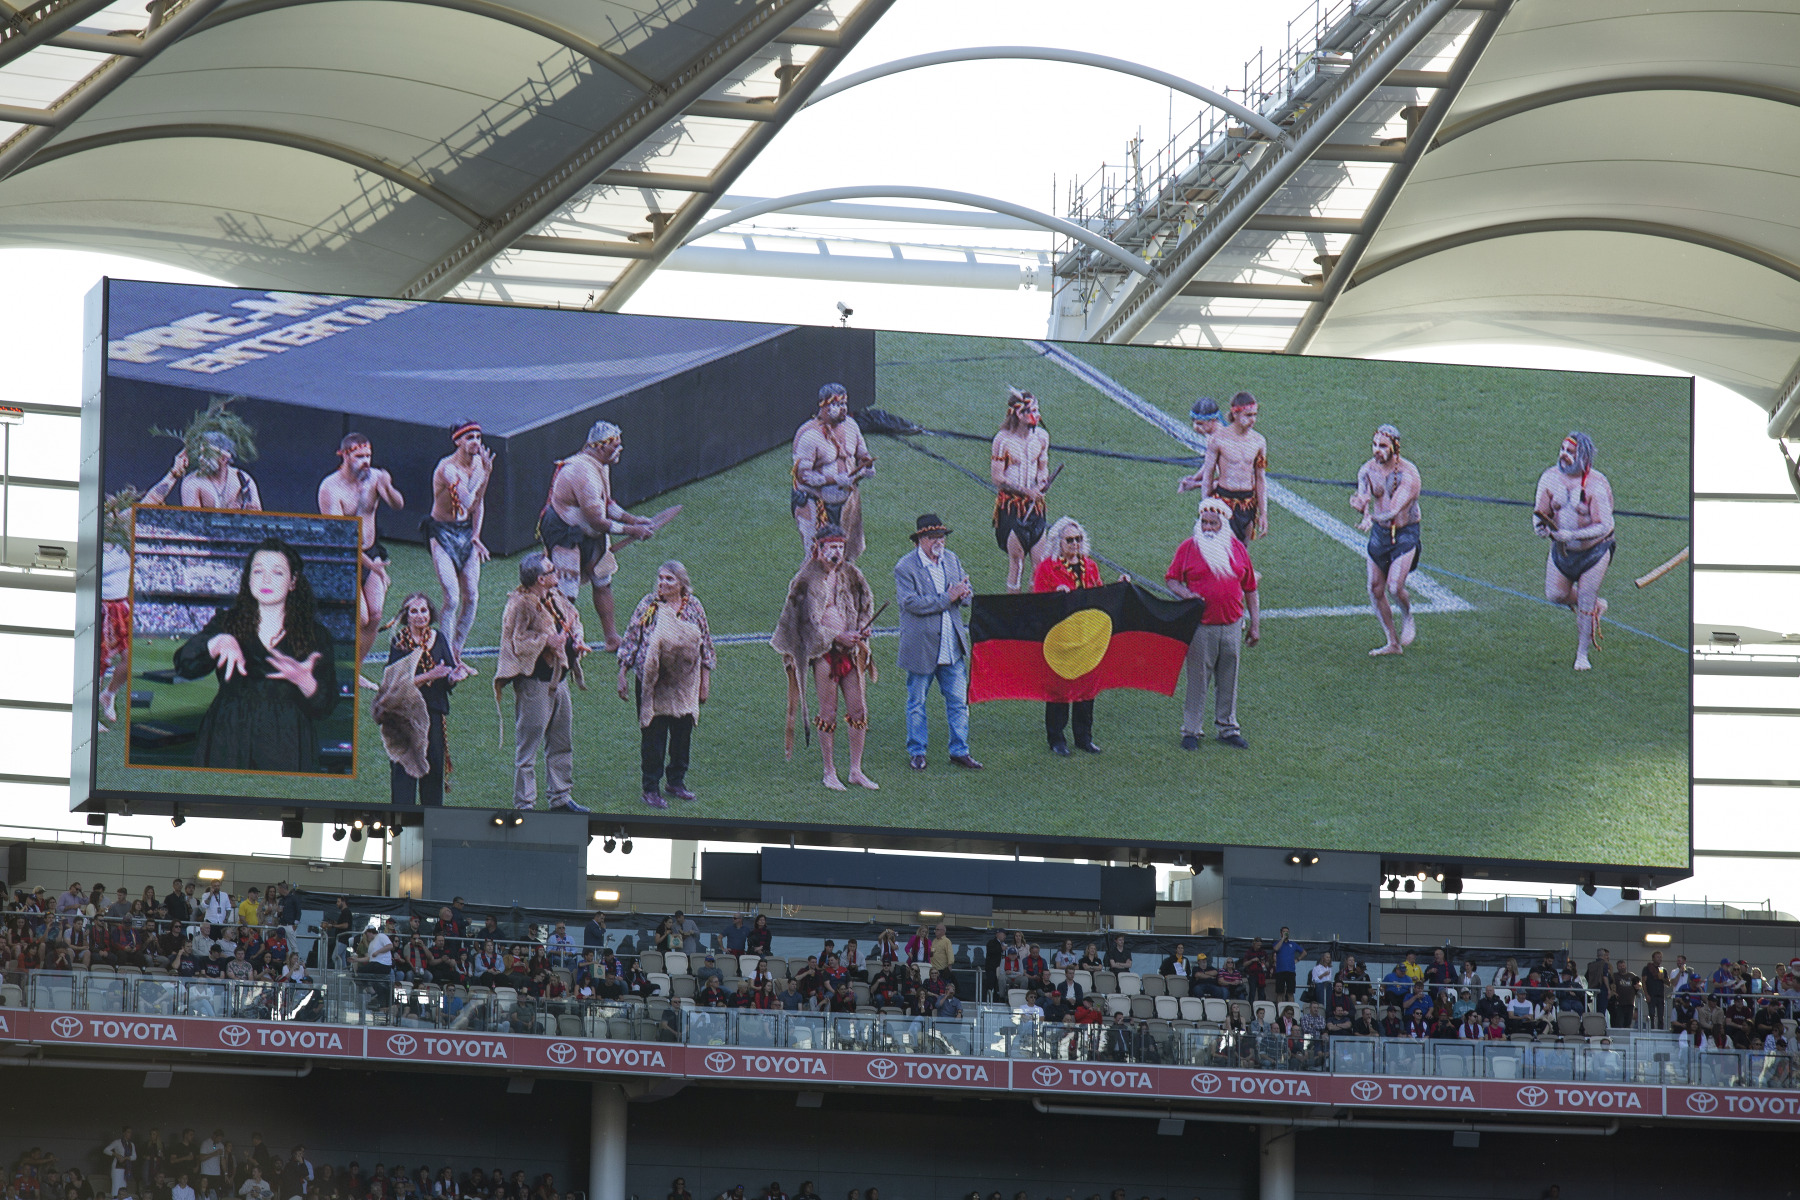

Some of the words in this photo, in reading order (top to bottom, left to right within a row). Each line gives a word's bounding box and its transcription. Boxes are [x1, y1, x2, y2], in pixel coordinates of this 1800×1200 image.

[90, 1021, 177, 1040] TOYOTA
[257, 1029, 342, 1049] TOYOTA
[424, 1038, 507, 1058] TOYOTA
[583, 1047, 665, 1067] TOYOTA
[742, 1056, 827, 1074] TOYOTA
[904, 1062, 988, 1082] TOYOTA
[1069, 1070, 1152, 1088] TOYOTA
[1228, 1077, 1311, 1096] TOYOTA
[1389, 1084, 1475, 1102] TOYOTA
[1555, 1090, 1641, 1108] TOYOTA
[1725, 1096, 1800, 1114] TOYOT
